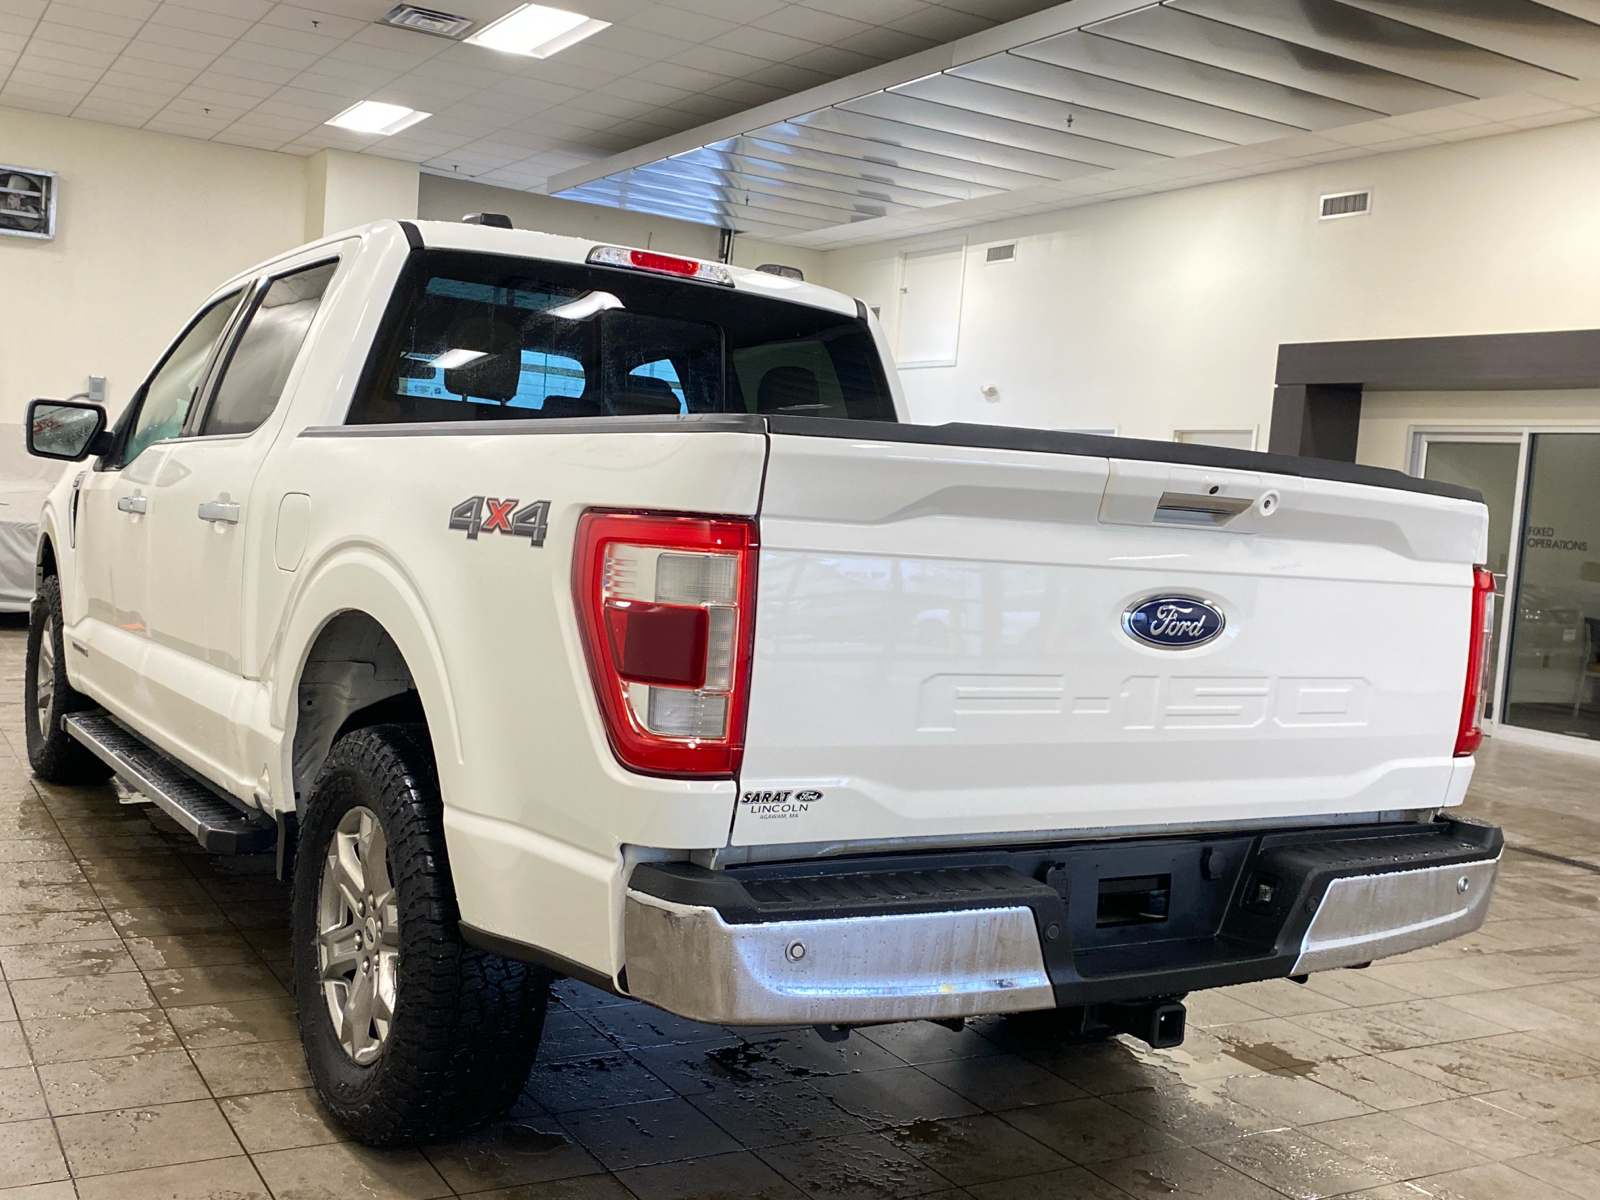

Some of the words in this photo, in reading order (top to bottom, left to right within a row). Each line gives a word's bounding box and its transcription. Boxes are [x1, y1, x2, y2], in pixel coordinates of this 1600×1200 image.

[1528, 526, 1555, 537] FIXED
[1527, 538, 1588, 551] OPERATIONS
[1150, 604, 1207, 636] Ford
[916, 673, 1373, 732] F-150
[741, 790, 793, 804] SARAT
[751, 804, 809, 813] LINCOLN
